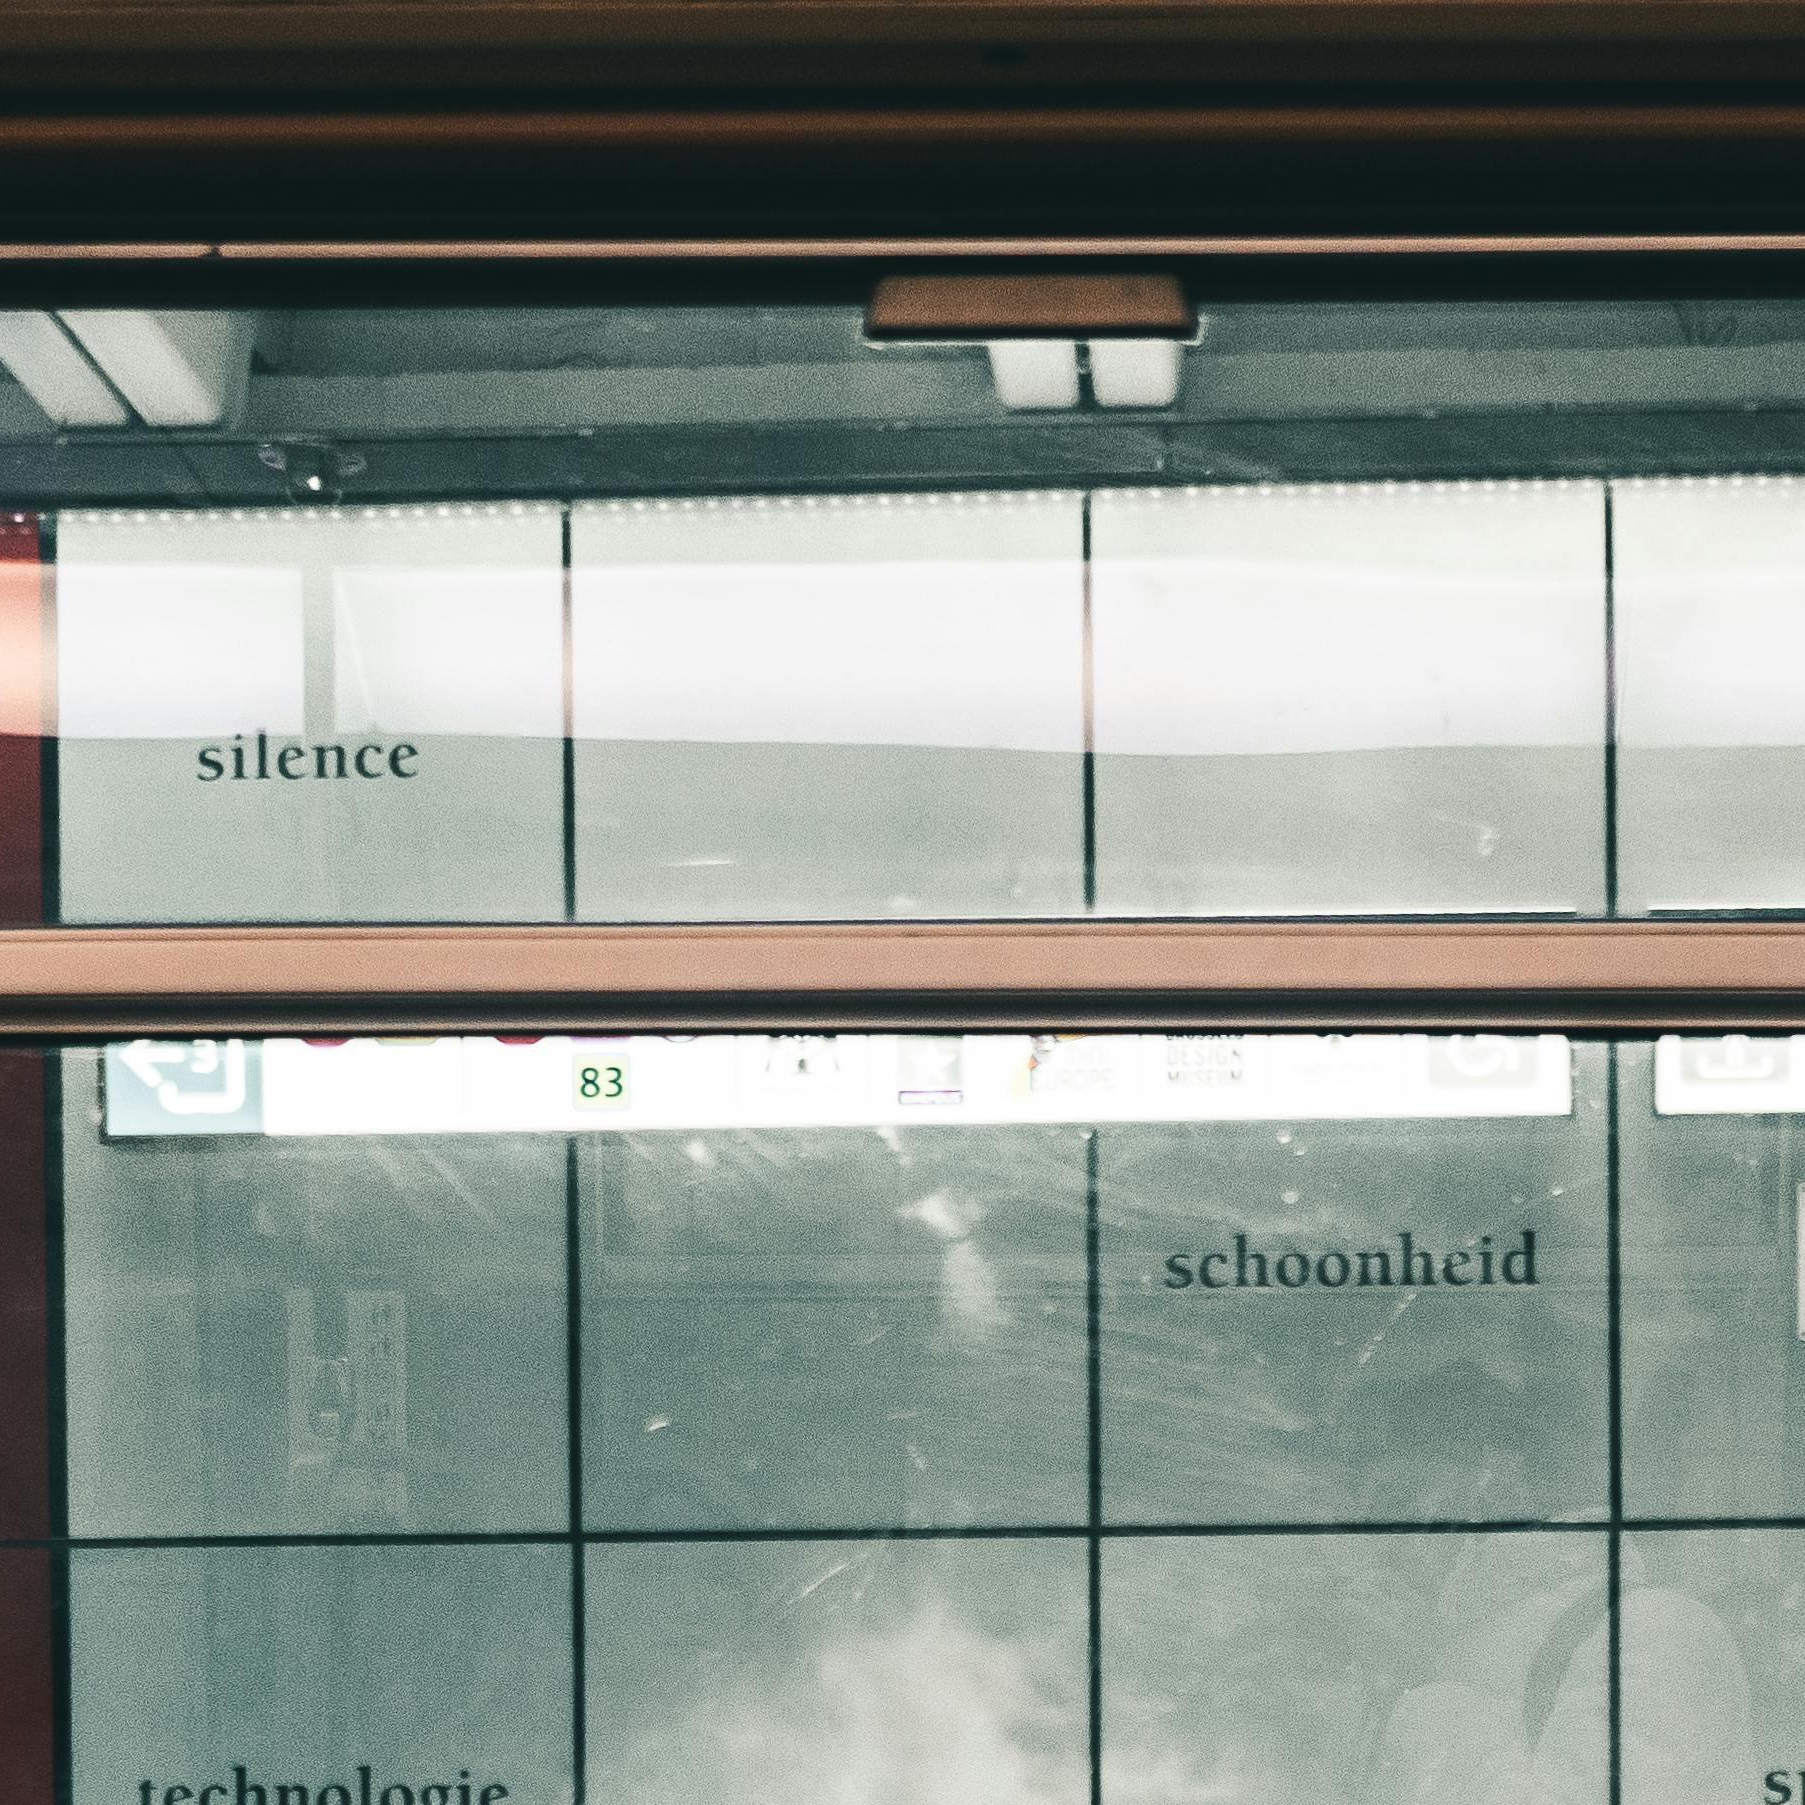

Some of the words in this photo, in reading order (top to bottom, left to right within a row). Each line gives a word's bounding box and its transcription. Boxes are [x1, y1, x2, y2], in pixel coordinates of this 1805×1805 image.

[196, 728, 419, 781] silence
[1166, 1044, 1243, 1066] DESIGN
[580, 1066, 624, 1099] 83
[1166, 1069, 1243, 1087] MUSEUM
[1164, 1229, 1540, 1289] schoonheid
